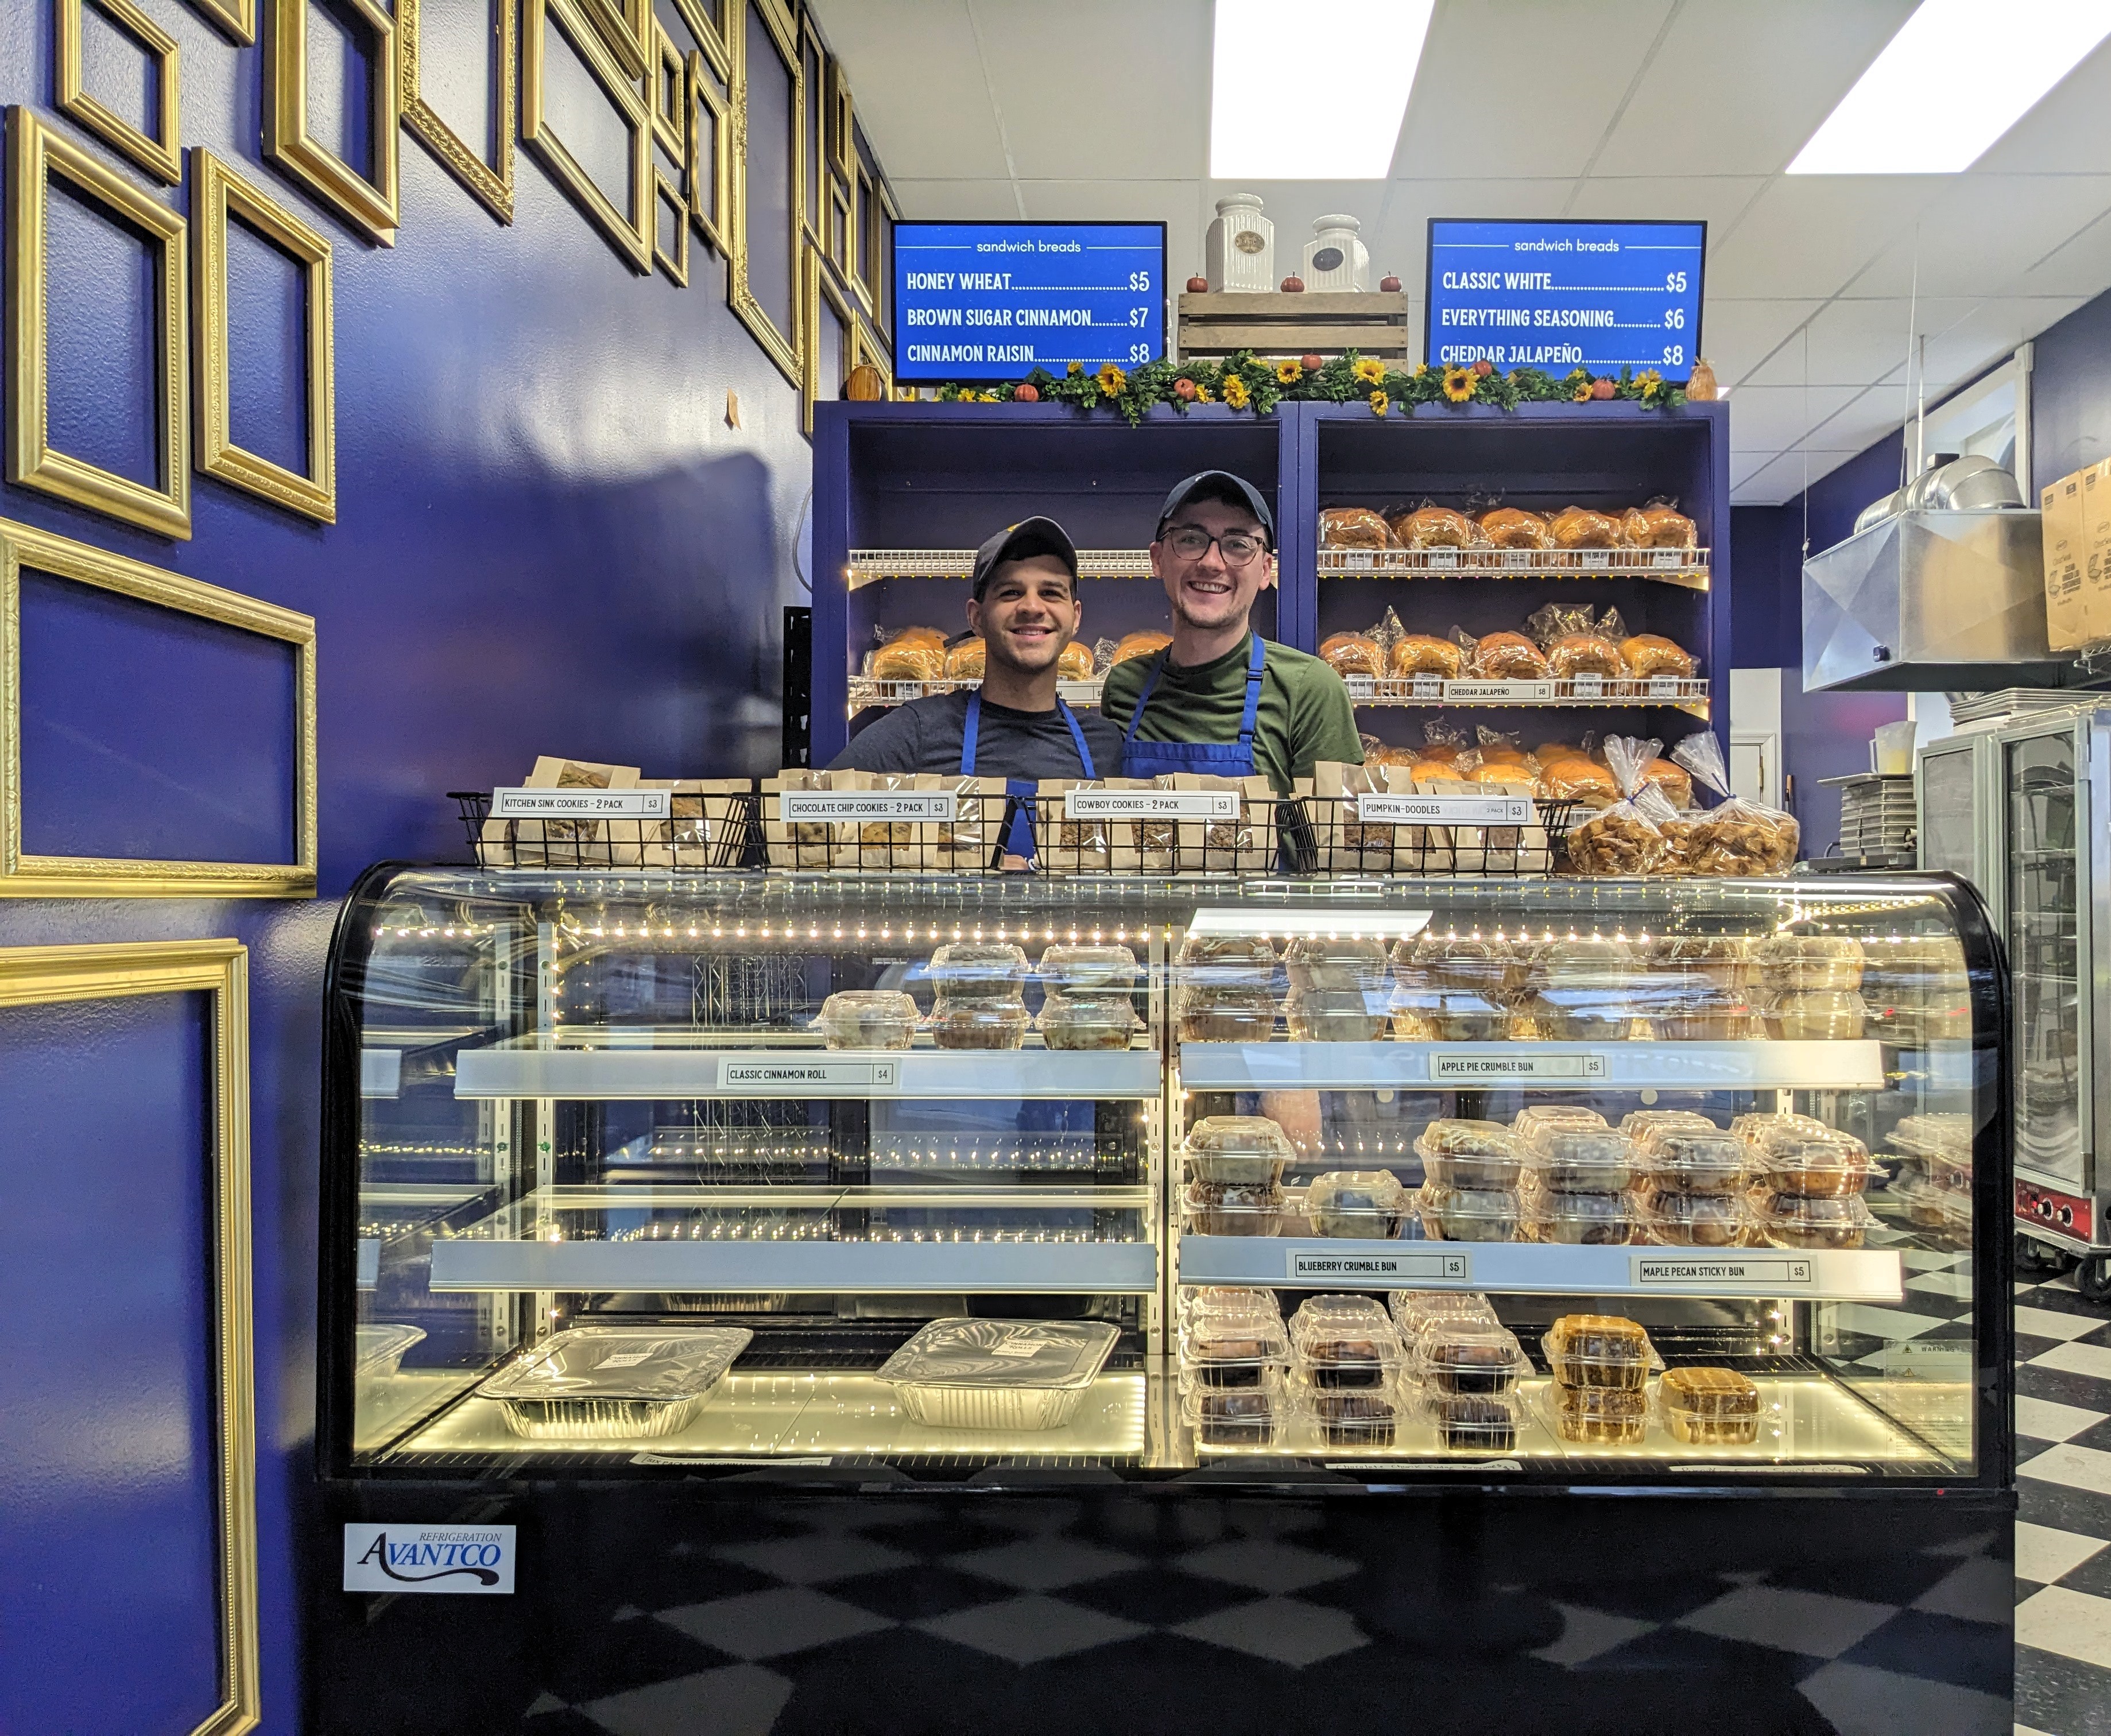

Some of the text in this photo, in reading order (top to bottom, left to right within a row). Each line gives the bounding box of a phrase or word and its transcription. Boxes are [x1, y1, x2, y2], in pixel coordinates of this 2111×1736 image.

[977, 240, 1081, 253] sandwich breads
[1515, 239, 1619, 252] sandwich breads
[907, 272, 1149, 292] HONEY WHEAT $5
[1443, 272, 1686, 292] CLASSIC WHITE $5
[908, 307, 1148, 328] BROWN SUGAR CINNAMON $7
[1442, 309, 1684, 329] EVERYTHING SEASONING $6
[908, 343, 1149, 364] CINNAMON RAISIN $8
[1440, 343, 1683, 366] CHEDDAR JALAPEÑO $8
[1478, 687, 1509, 696] JALAPEÑO
[505, 799, 536, 808] KITCHEN
[537, 799, 555, 808] SINK
[556, 799, 588, 808] COOKIES
[596, 799, 602, 809] 2
[604, 800, 623, 809] PACK
[648, 800, 657, 809] $3
[792, 803, 835, 813] CHOCOLATE
[837, 803, 854, 812] CHIP
[856, 803, 888, 812] COOKIES
[896, 803, 902, 813] 2
[904, 804, 923, 812] PACK
[934, 804, 943, 813] $3
[1077, 800, 1110, 809] COWBOY
[1112, 800, 1144, 809] COOKIES
[1152, 800, 1158, 809] 2
[1159, 800, 1179, 809] PACK
[1218, 801, 1227, 810] $3
[1366, 804, 1440, 814] PUMPKIN-DOODLES
[1512, 807, 1522, 816] $3
[1441, 1061, 1599, 1072] APPLE PIE CRUMBLE BUN $5
[730, 1070, 888, 1079] CLASSIC CINNAMON ROLL $4
[1299, 1261, 1459, 1272] BLUEBERRY CRUMBLE BUN $5
[1643, 1266, 1804, 1276] MAPLE PECAN STICKY BUN $5
[419, 1532, 502, 1541] REFRIGERATION
[357, 1532, 501, 1576] AVANTCO
